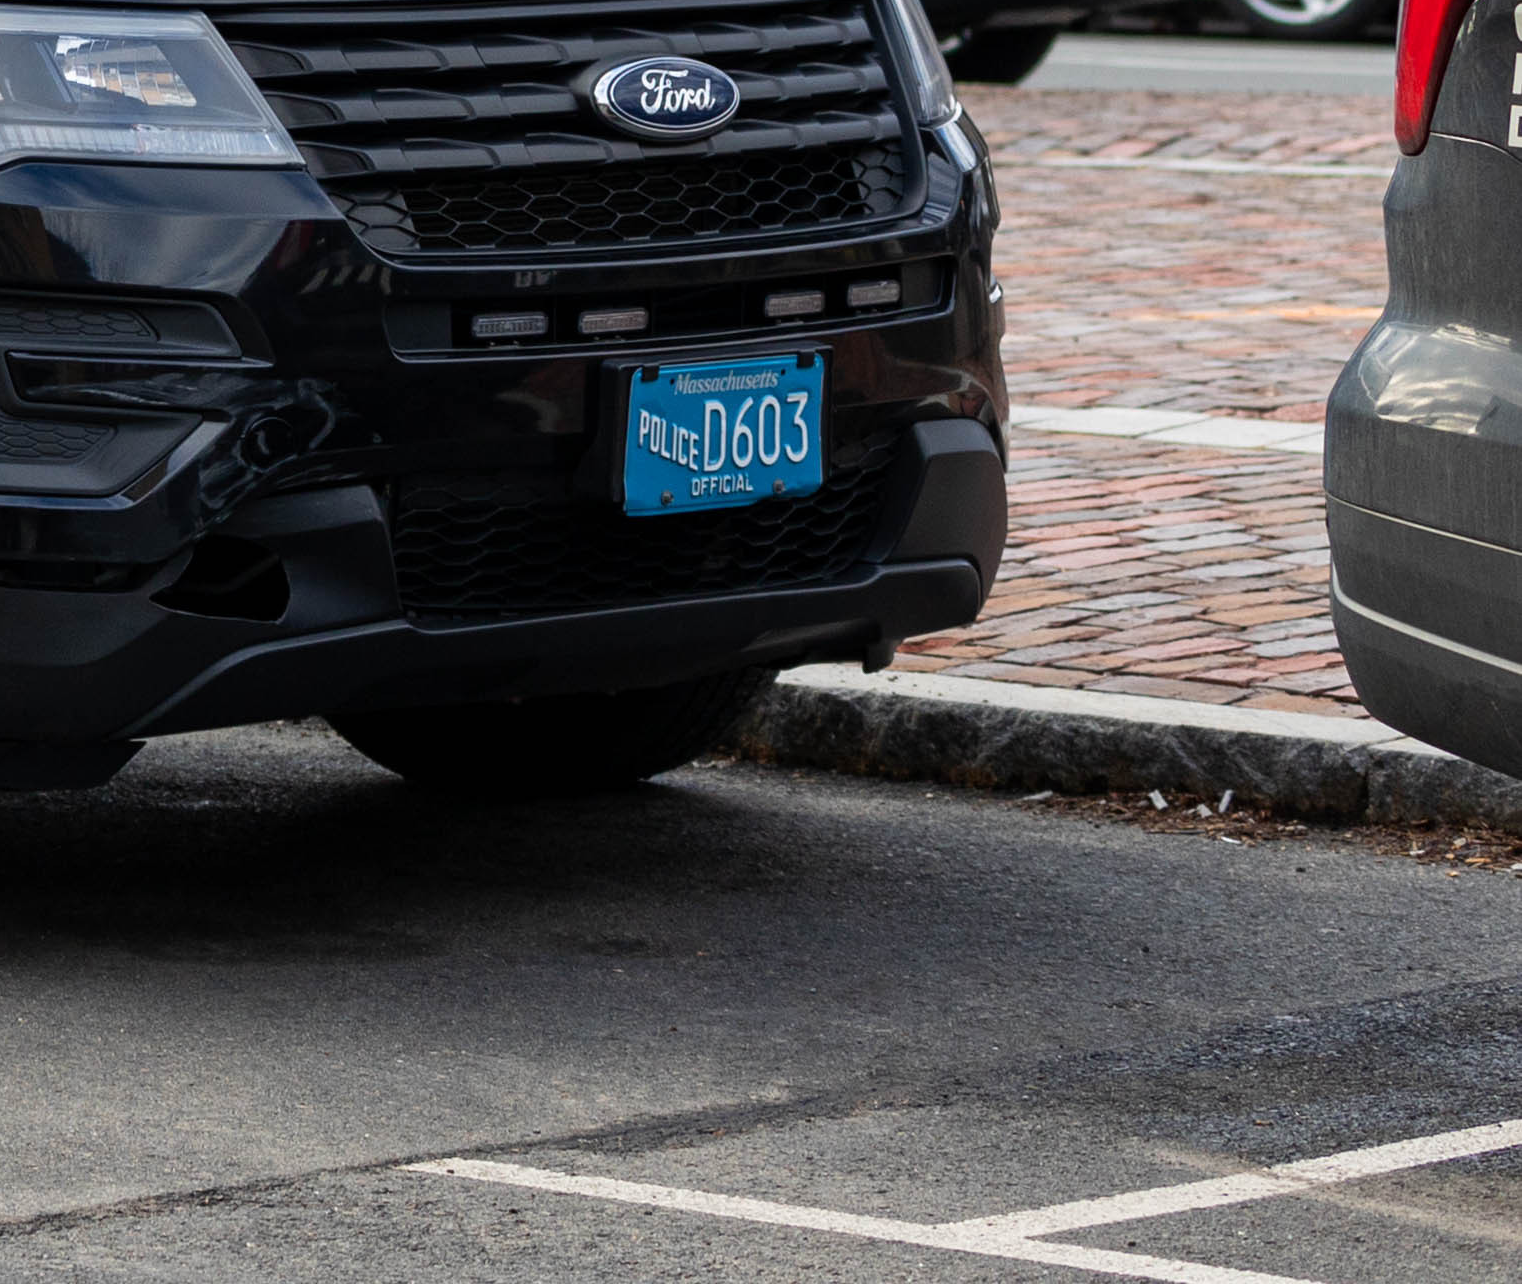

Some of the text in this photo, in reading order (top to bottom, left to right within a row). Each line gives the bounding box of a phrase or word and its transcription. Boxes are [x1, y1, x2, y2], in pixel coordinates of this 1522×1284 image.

[640, 69, 716, 115] Ford
[674, 369, 779, 396] Massachusetts
[639, 391, 809, 472] POLICE D603
[691, 474, 754, 497] OFFICIAL
